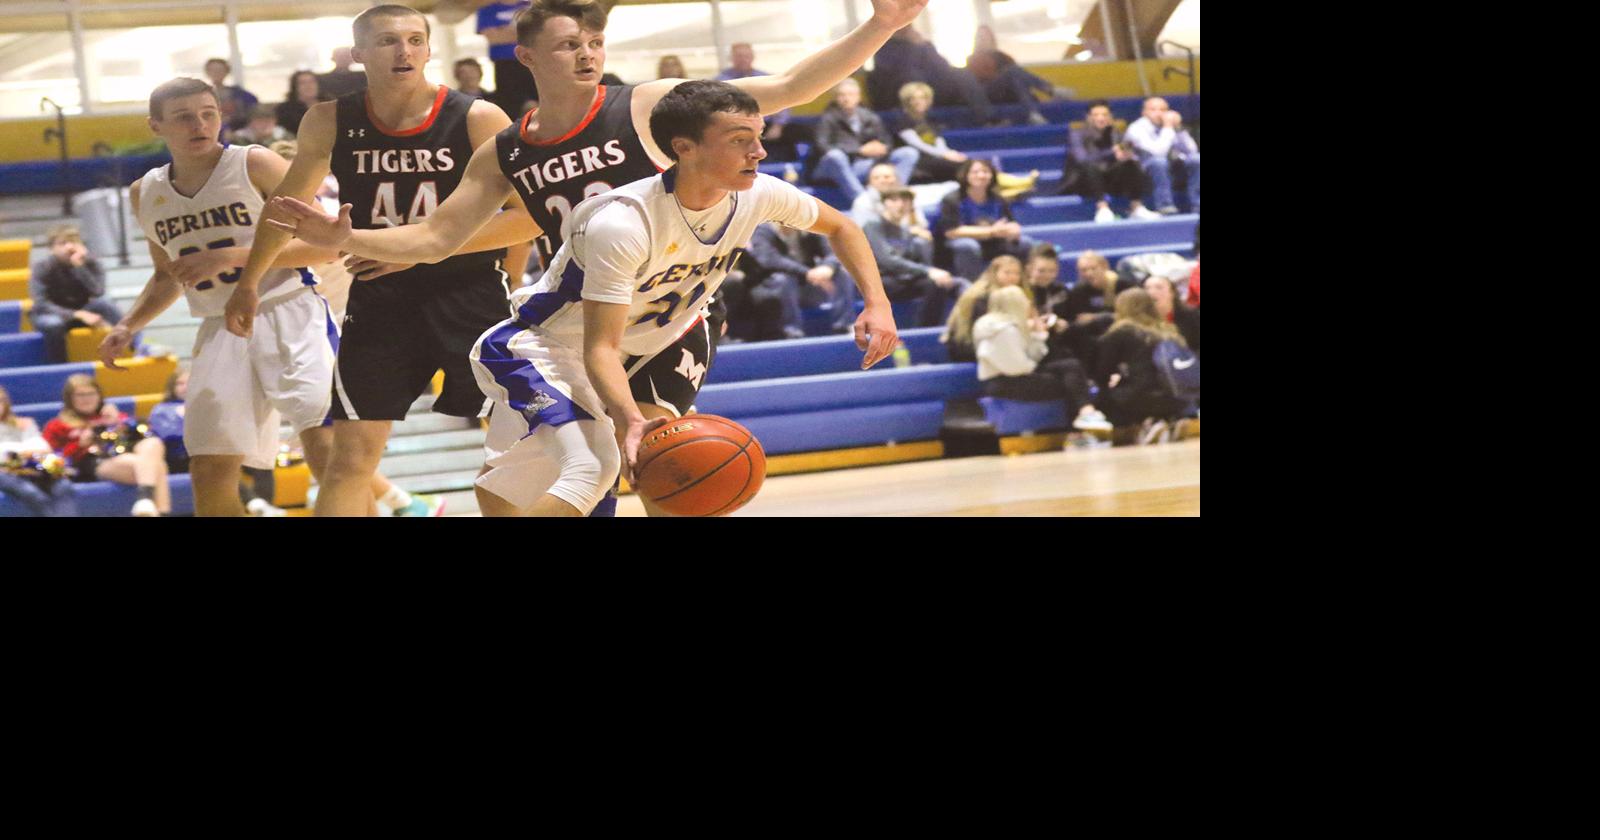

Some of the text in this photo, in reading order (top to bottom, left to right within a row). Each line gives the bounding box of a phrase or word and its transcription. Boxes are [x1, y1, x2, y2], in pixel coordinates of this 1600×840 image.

[352, 147, 454, 174] TIGERS
[512, 139, 626, 195] TIGERS
[155, 201, 252, 246] GERING
[371, 181, 438, 227] 44
[674, 347, 707, 392] M
